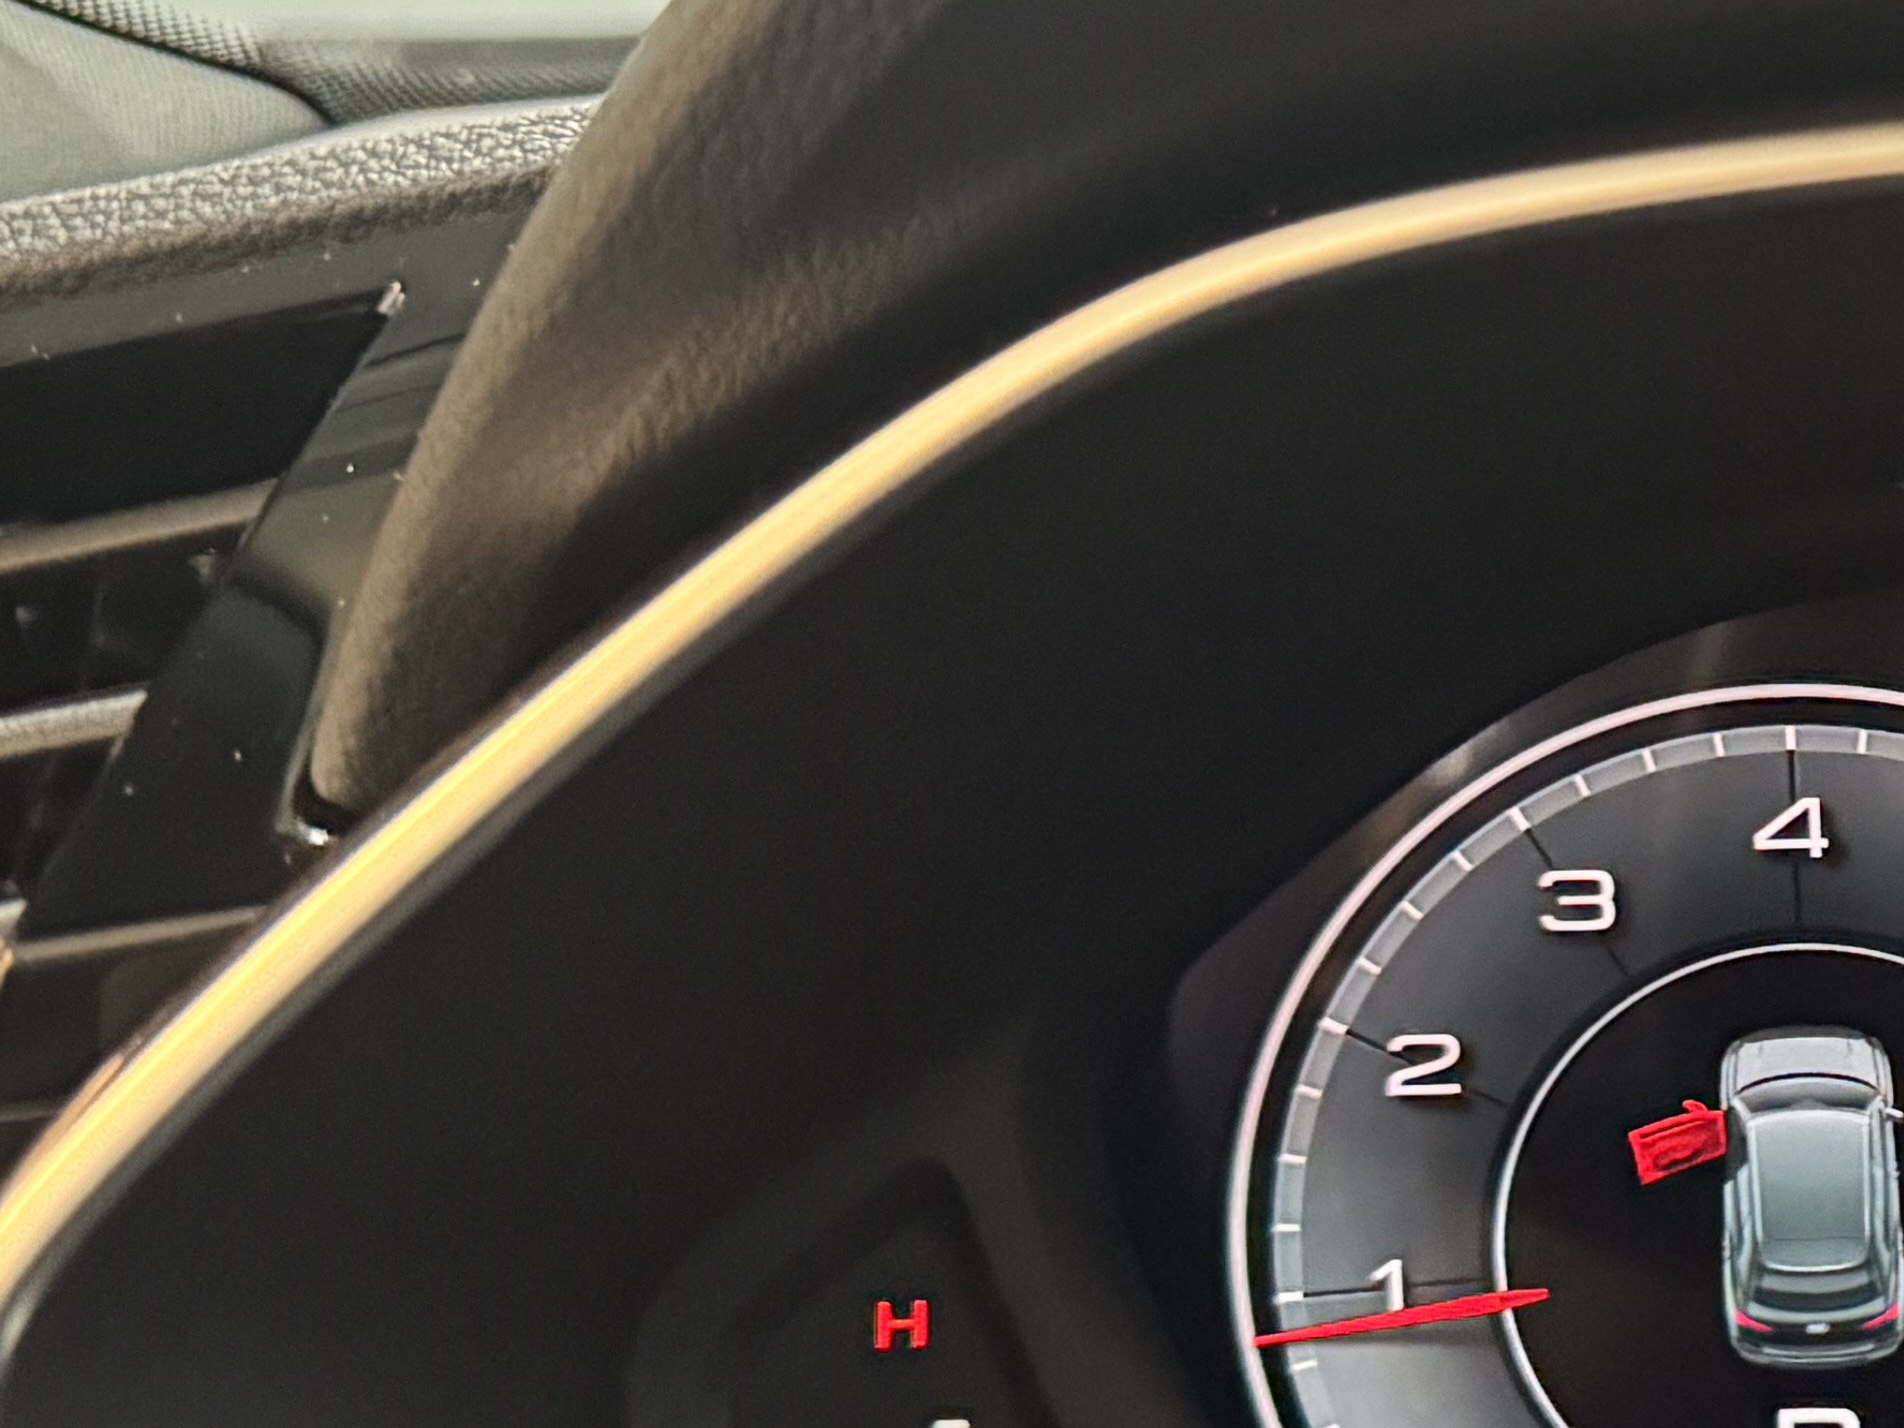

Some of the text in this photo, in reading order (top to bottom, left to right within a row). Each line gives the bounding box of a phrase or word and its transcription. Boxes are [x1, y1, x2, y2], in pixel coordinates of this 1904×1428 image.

[1753, 796, 1830, 859] 4
[1538, 869, 1616, 932] 3
[1387, 1033, 1462, 1097] 2
[1368, 1257, 1406, 1314] 1
[874, 1299, 931, 1353] H
